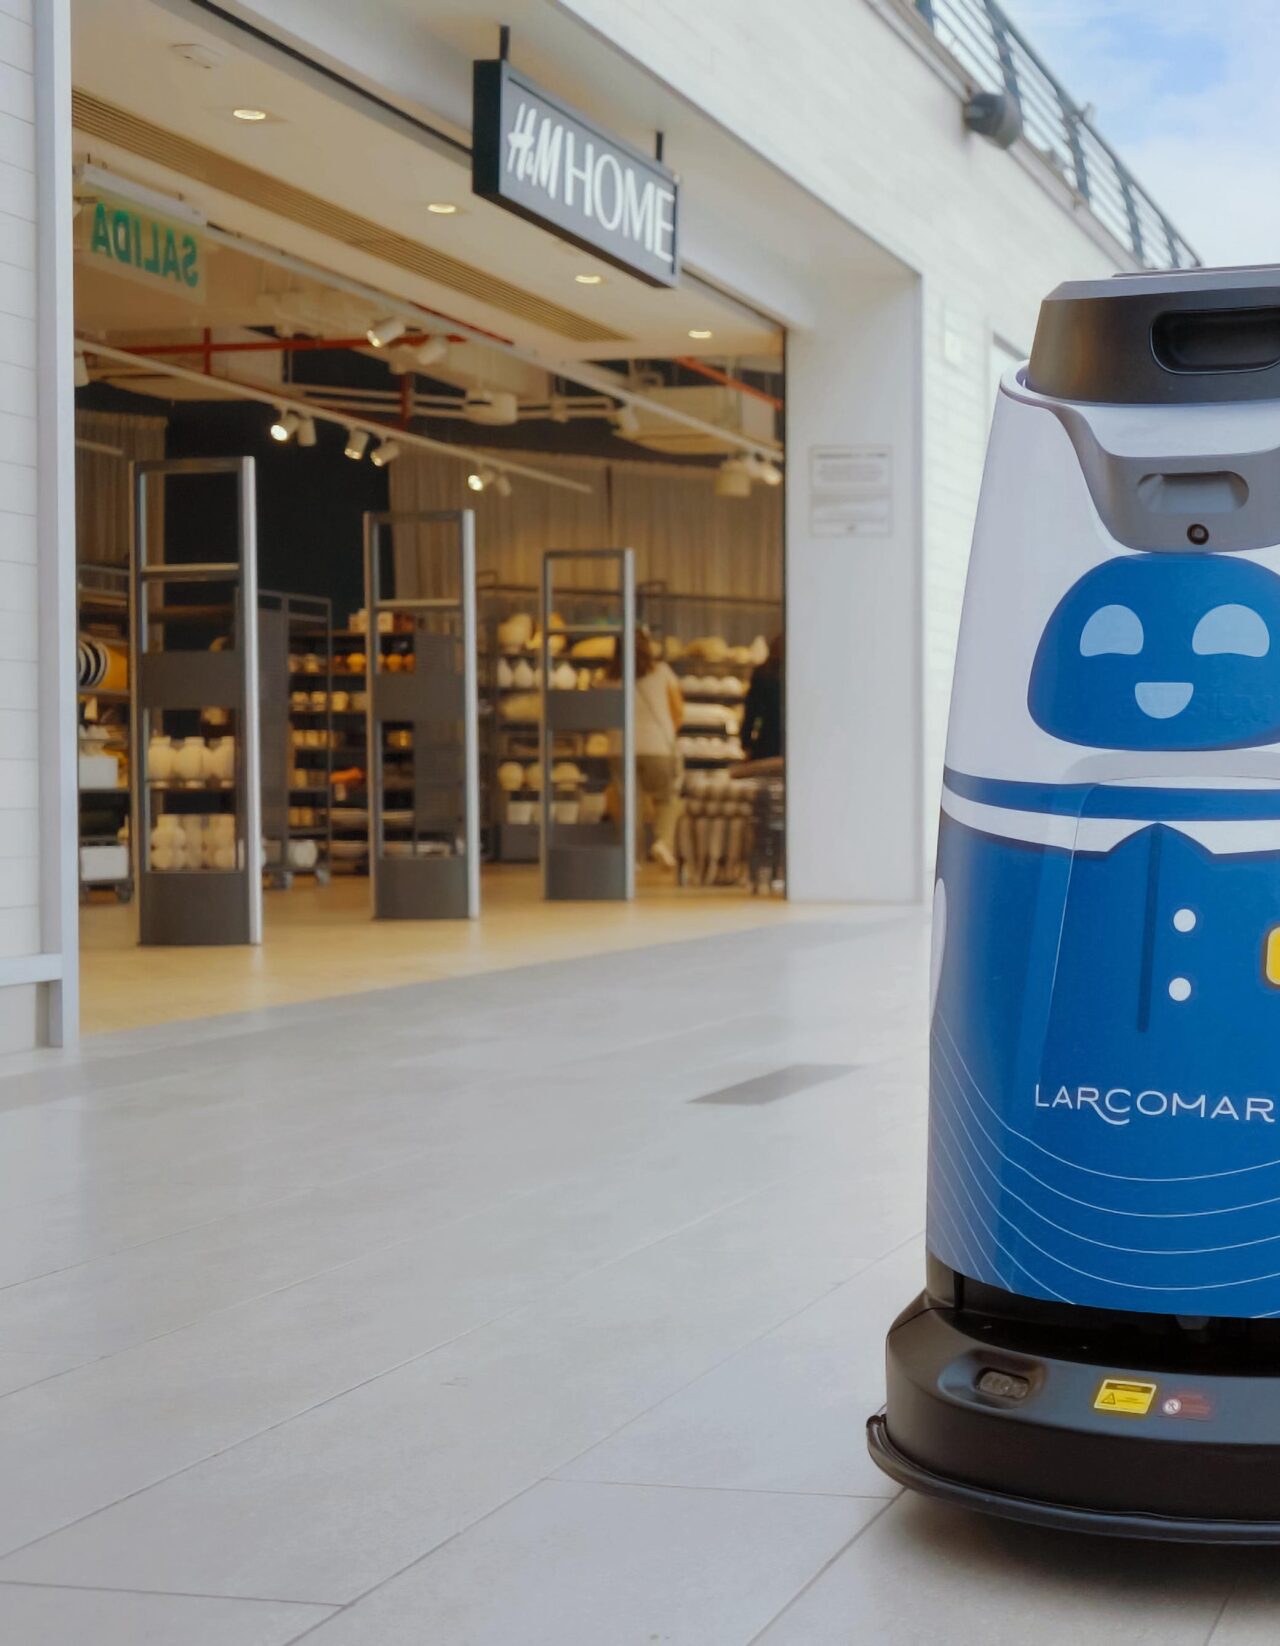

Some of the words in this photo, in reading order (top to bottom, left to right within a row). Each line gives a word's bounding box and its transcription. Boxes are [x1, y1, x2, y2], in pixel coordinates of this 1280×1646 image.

[507, 102, 563, 200] H&M
[564, 129, 675, 264] HOME
[1034, 1083, 1277, 1126] LARCOMAR
